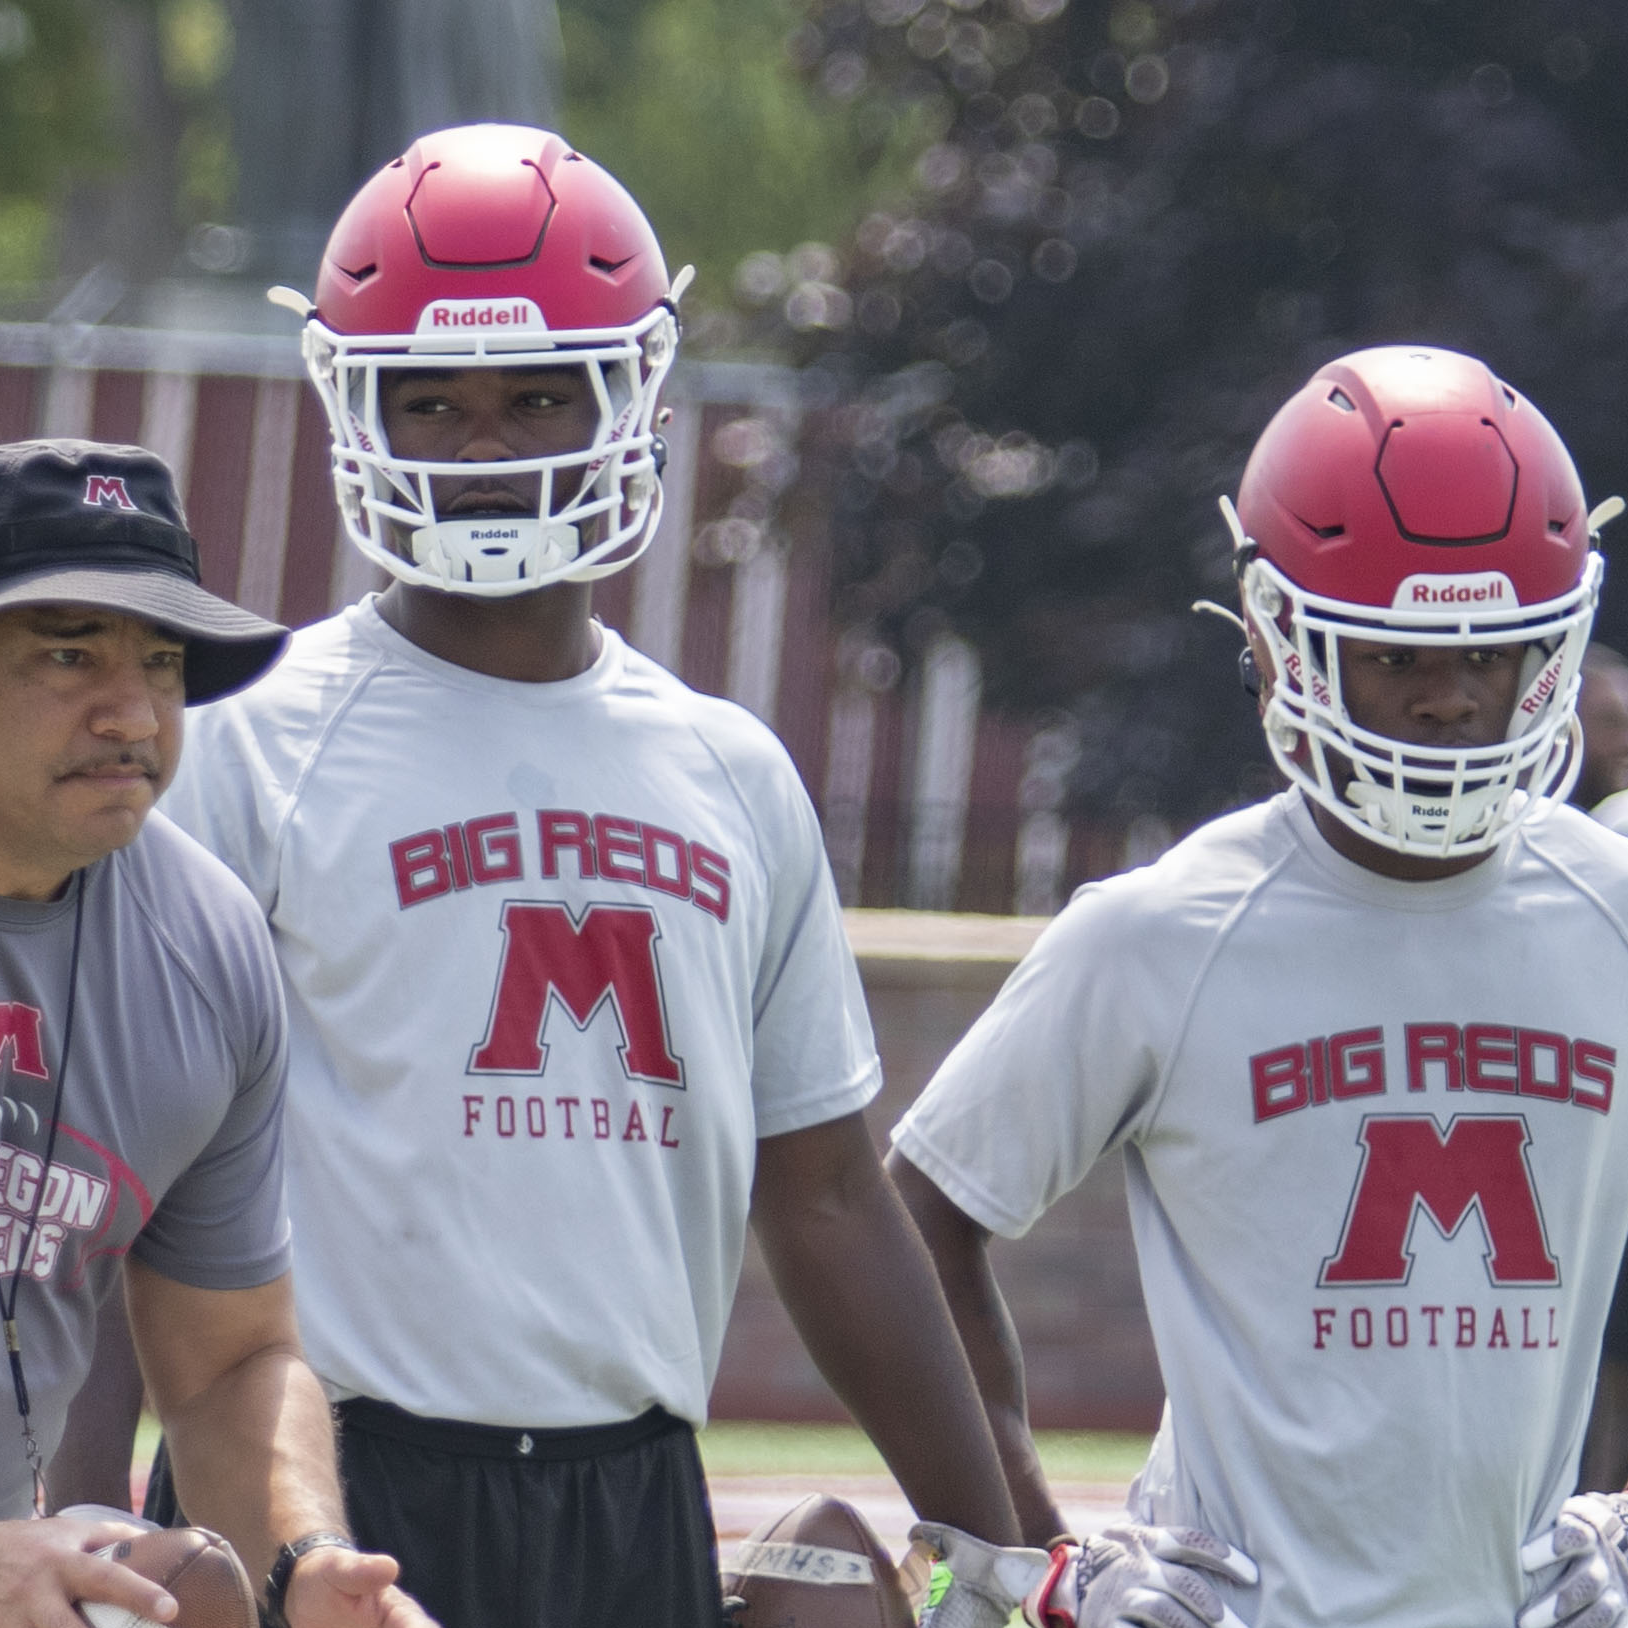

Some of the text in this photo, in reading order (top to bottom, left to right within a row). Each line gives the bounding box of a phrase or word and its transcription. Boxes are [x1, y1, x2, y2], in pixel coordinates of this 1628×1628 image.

[432, 305, 528, 327] Riddell
[83, 475, 139, 511] M
[470, 529, 519, 540] Riddell
[1412, 580, 1503, 603] Riddell
[1411, 804, 1450, 818] Ridde
[388, 808, 732, 925] BIG REDS
[465, 898, 687, 1091] M
[1249, 1021, 1618, 1124] BIG REDS
[1315, 1112, 1563, 1289] M
[1312, 1306, 1560, 1350] FOOTBALL
